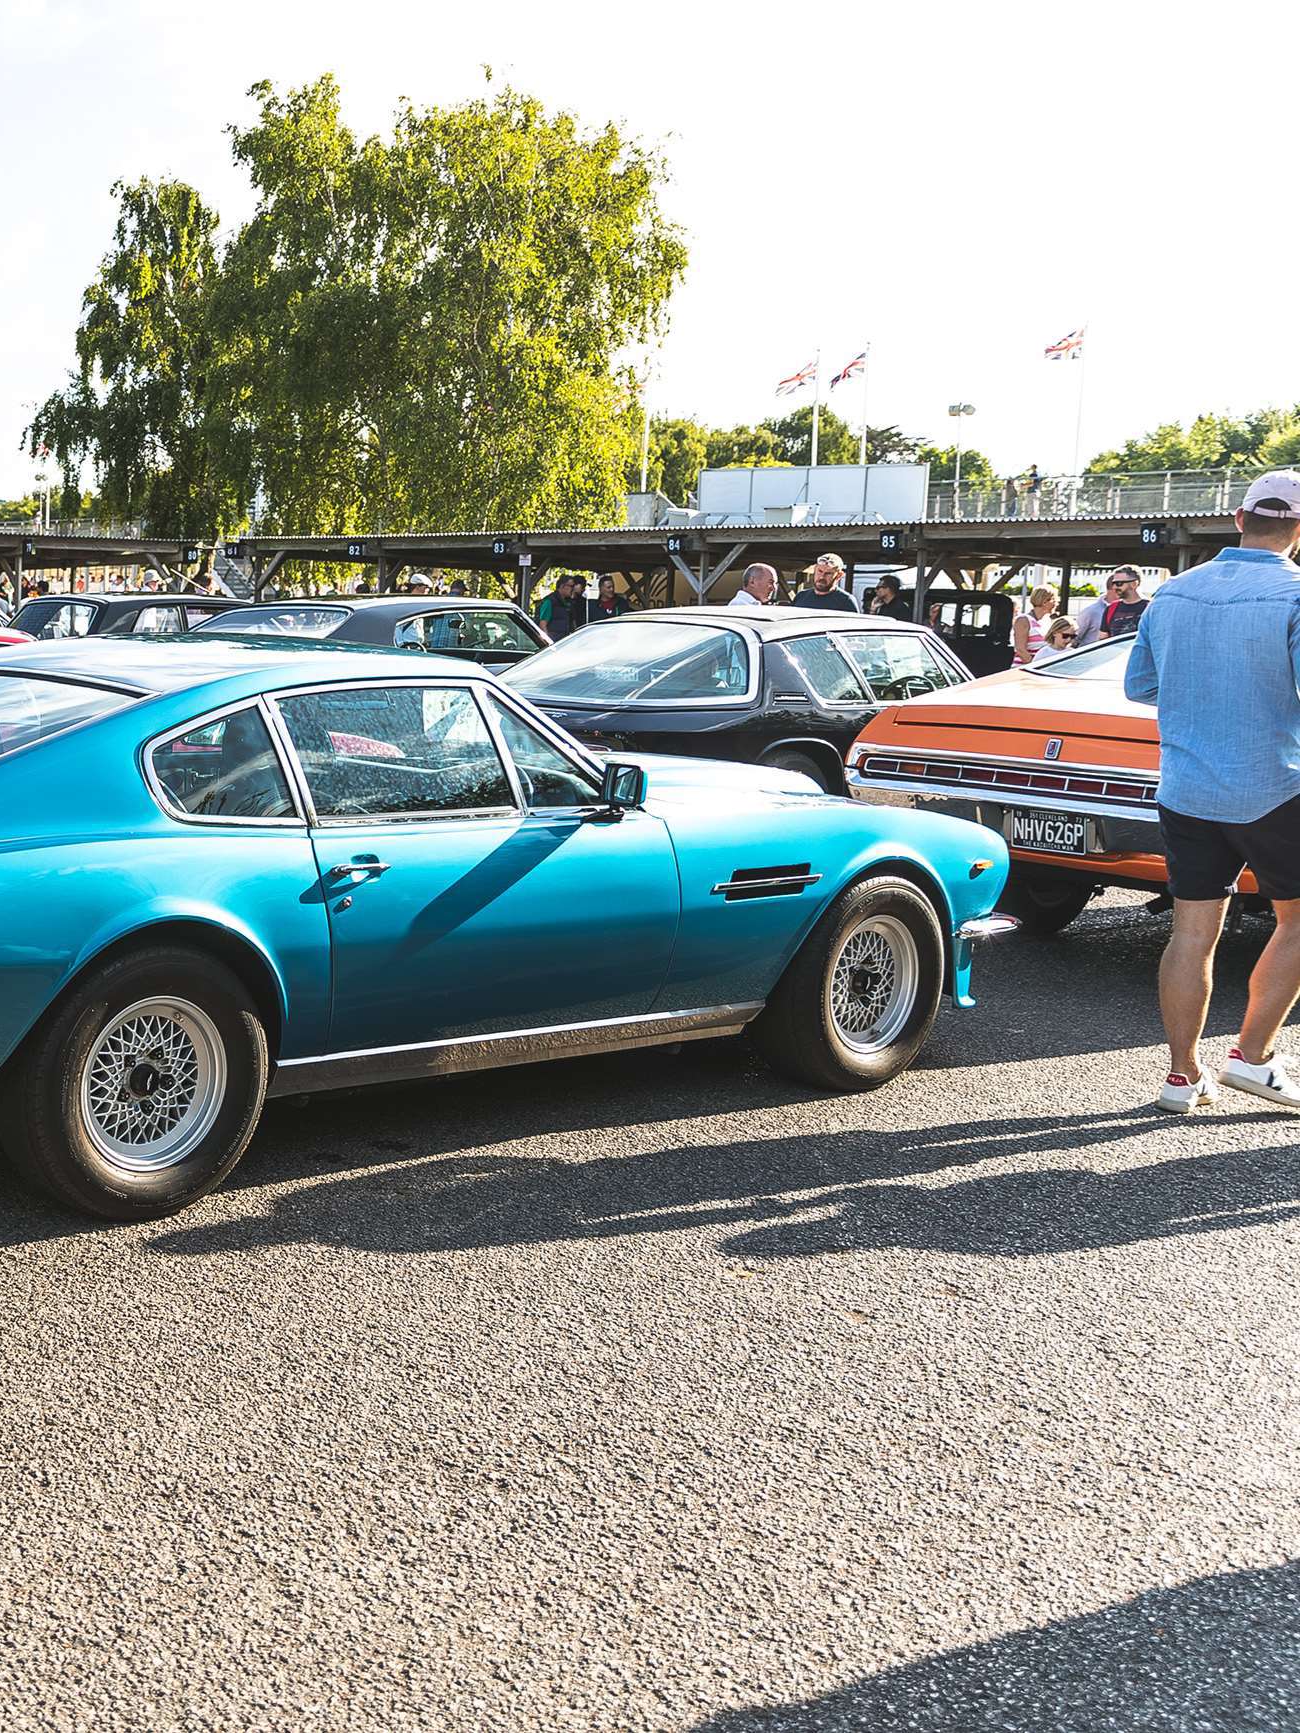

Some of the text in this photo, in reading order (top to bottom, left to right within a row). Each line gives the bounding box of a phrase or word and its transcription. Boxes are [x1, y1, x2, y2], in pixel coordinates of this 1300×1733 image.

[882, 535, 896, 548] 85
[1142, 529, 1157, 543] 86
[227, 546, 237, 555] 81
[348, 545, 360, 556] 82
[493, 543, 504, 553] 83
[668, 539, 680, 551] 84
[187, 550, 197, 560] 80
[1014, 818, 1083, 846] NHV626P
